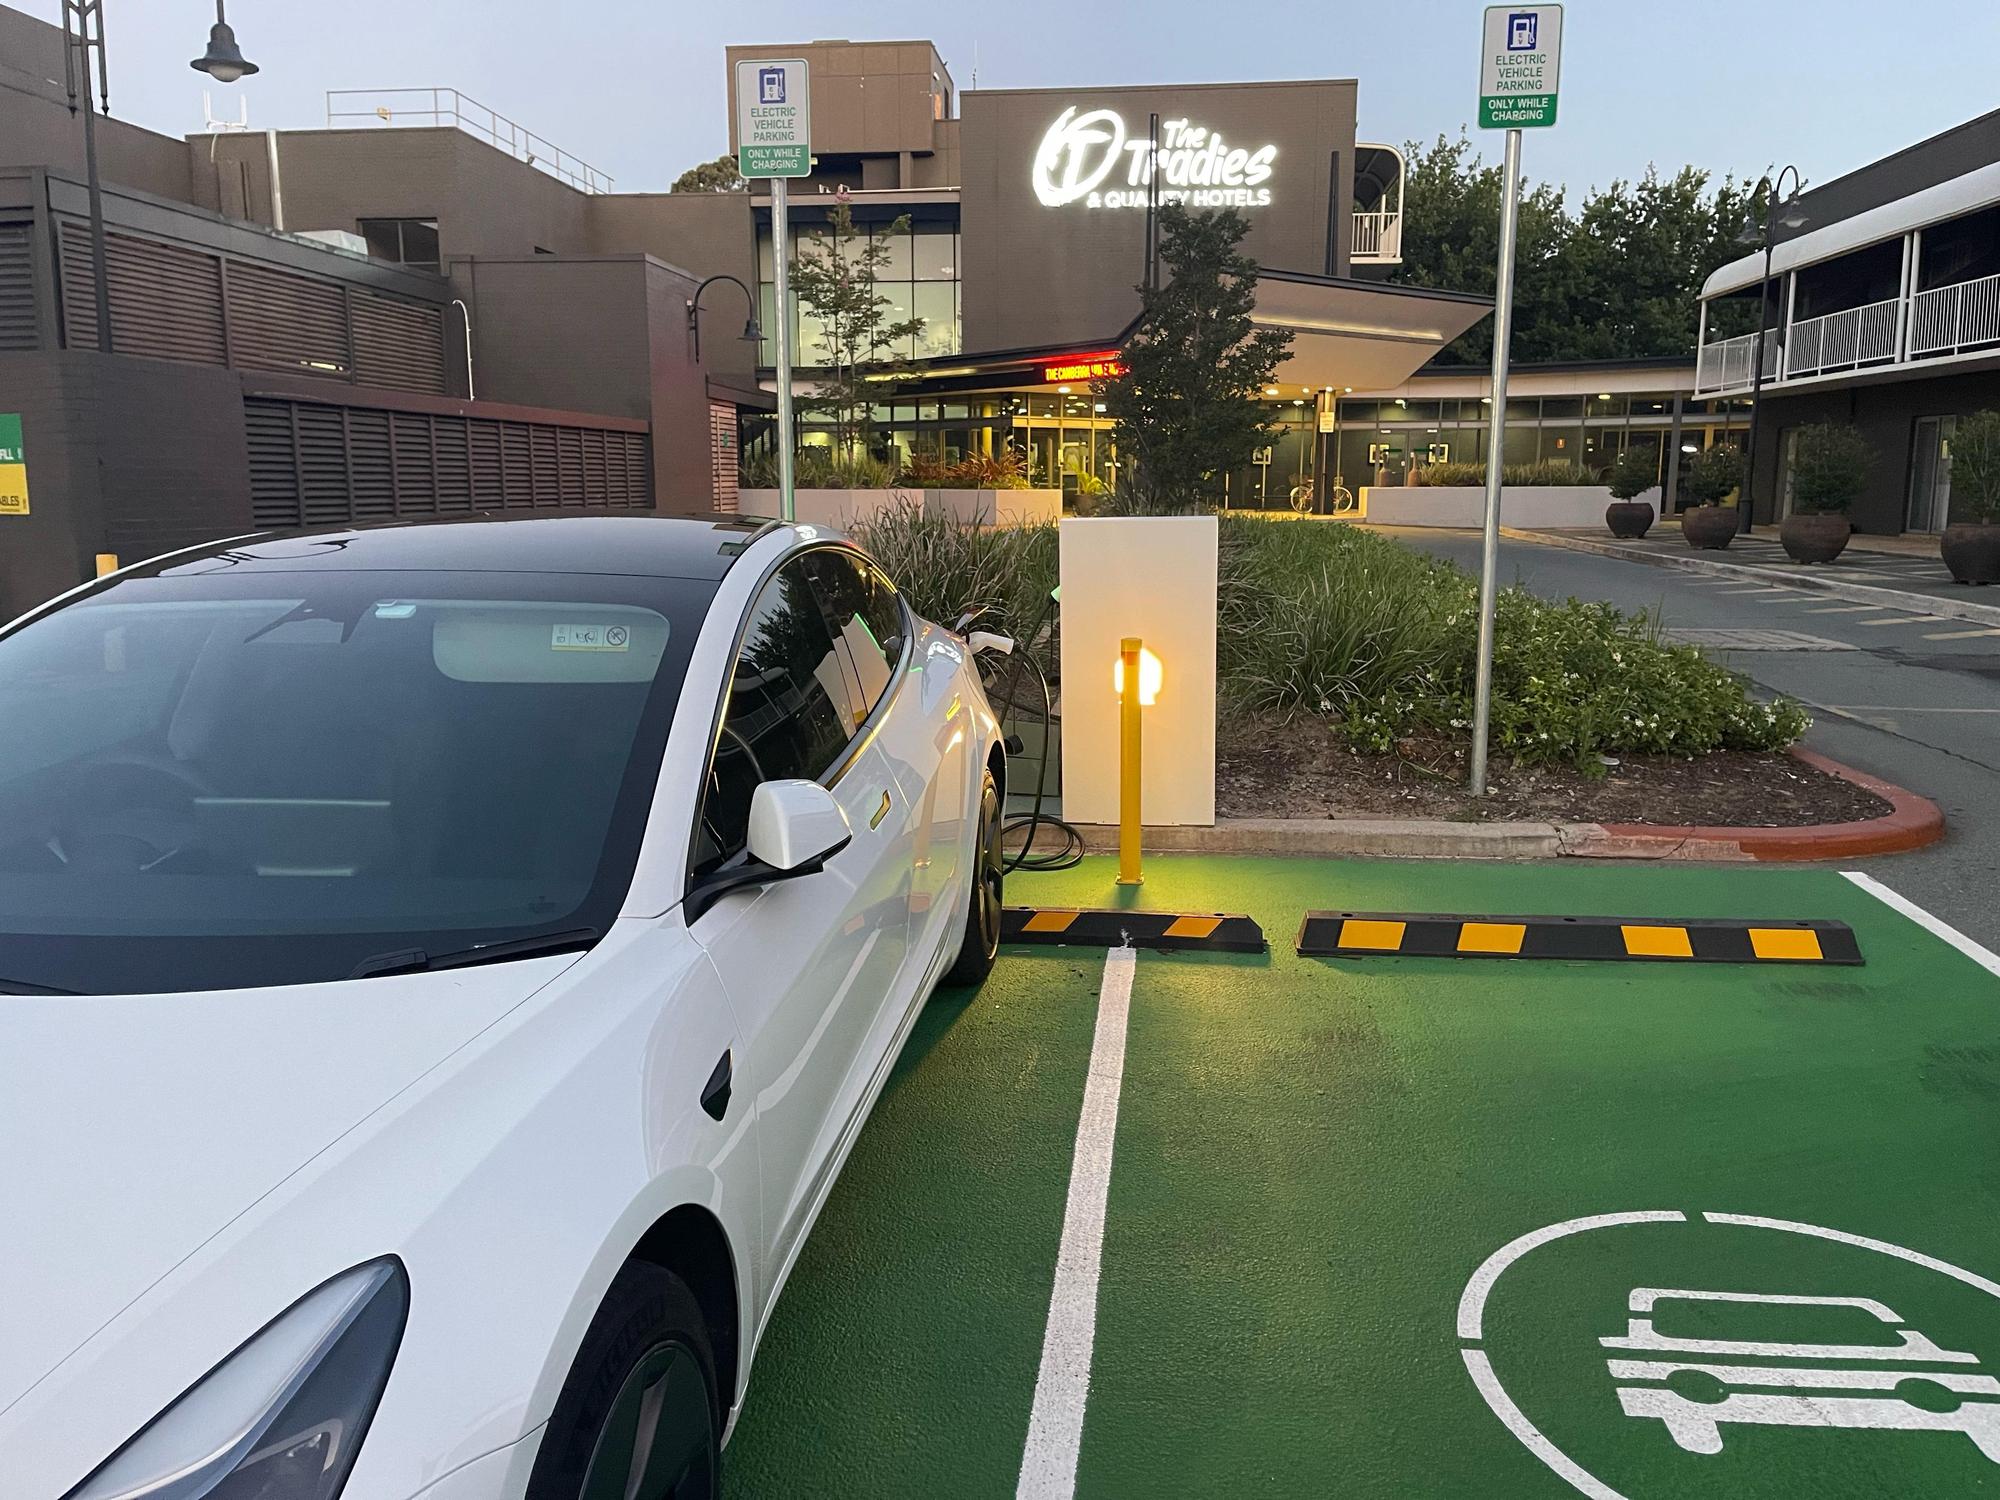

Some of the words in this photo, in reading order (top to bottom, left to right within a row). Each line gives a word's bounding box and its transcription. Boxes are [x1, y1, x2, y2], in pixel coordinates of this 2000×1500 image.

[1496, 54, 1546, 65] ELECTRIC
[1498, 67, 1543, 78] VEHICLE
[1496, 80, 1543, 91] PARKING
[1488, 99, 1514, 109] ONLY
[1517, 97, 1549, 108] WHILE
[750, 107, 796, 118] ELECTRIC
[1491, 110, 1544, 121] CHARGING
[754, 119, 794, 130] VEHICLE
[753, 131, 795, 141] PARKING
[1163, 118, 1207, 149] The
[747, 149, 771, 158] ONLY
[773, 148, 801, 158] WHILE
[751, 159, 798, 170] CHARGING
[1125, 132, 1277, 187] Tradies
[1086, 191, 1101, 209] &
[1193, 188, 1272, 207] HOTELS
